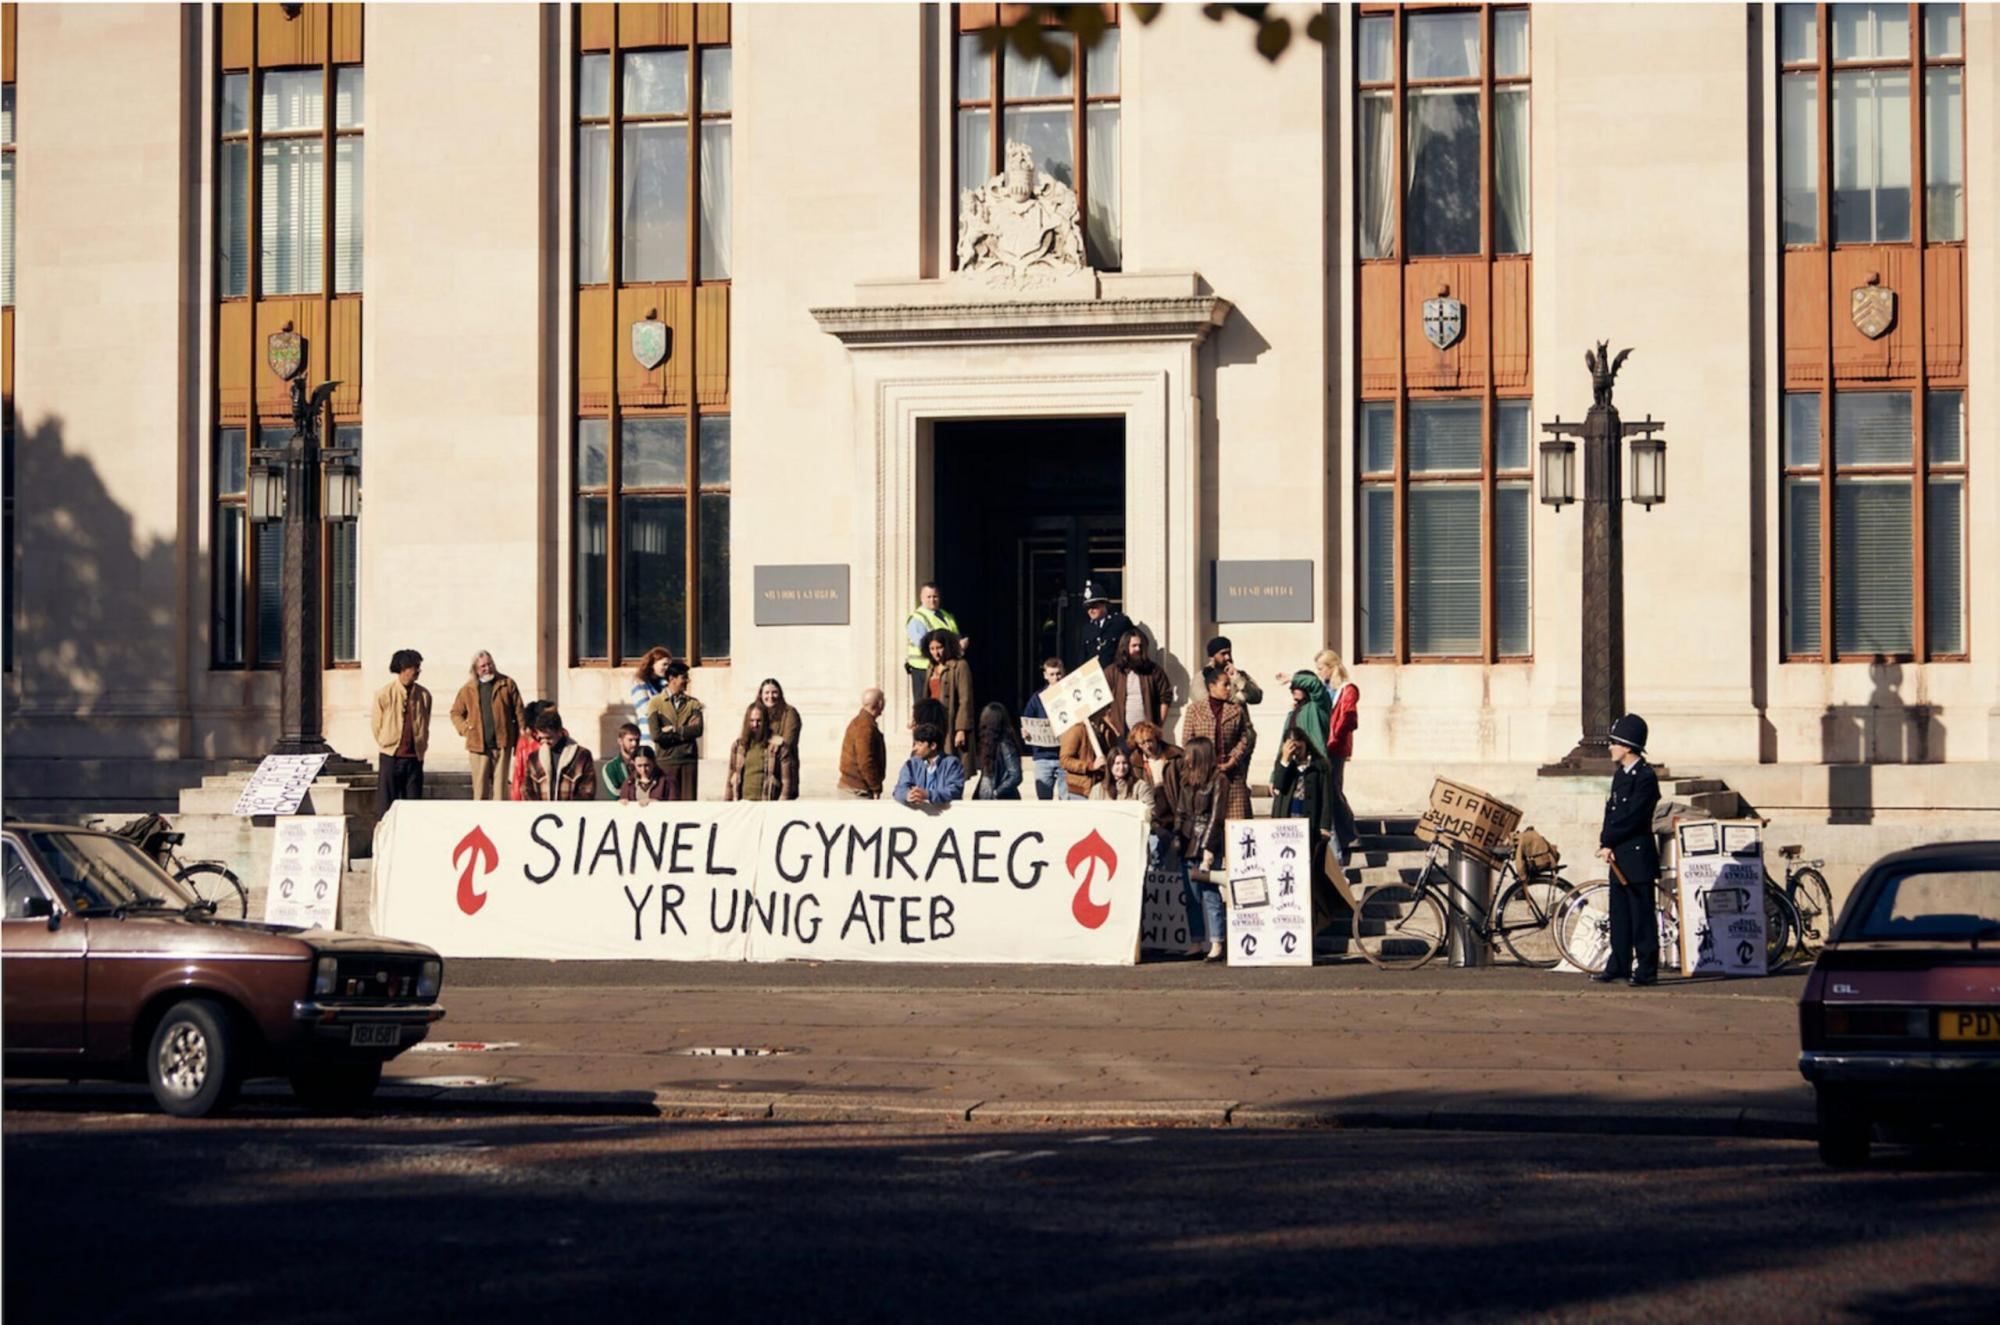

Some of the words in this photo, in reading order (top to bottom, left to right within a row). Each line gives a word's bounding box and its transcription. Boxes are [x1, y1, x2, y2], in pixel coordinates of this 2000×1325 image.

[1422, 809, 1499, 847] GYMRAE
[1440, 789, 1506, 828] SIANEL
[523, 813, 738, 885] SIANEL
[775, 820, 1049, 890] GYMRAEG
[624, 884, 688, 941] YR
[710, 887, 823, 944] UNIG
[840, 889, 955, 944] ATEB
